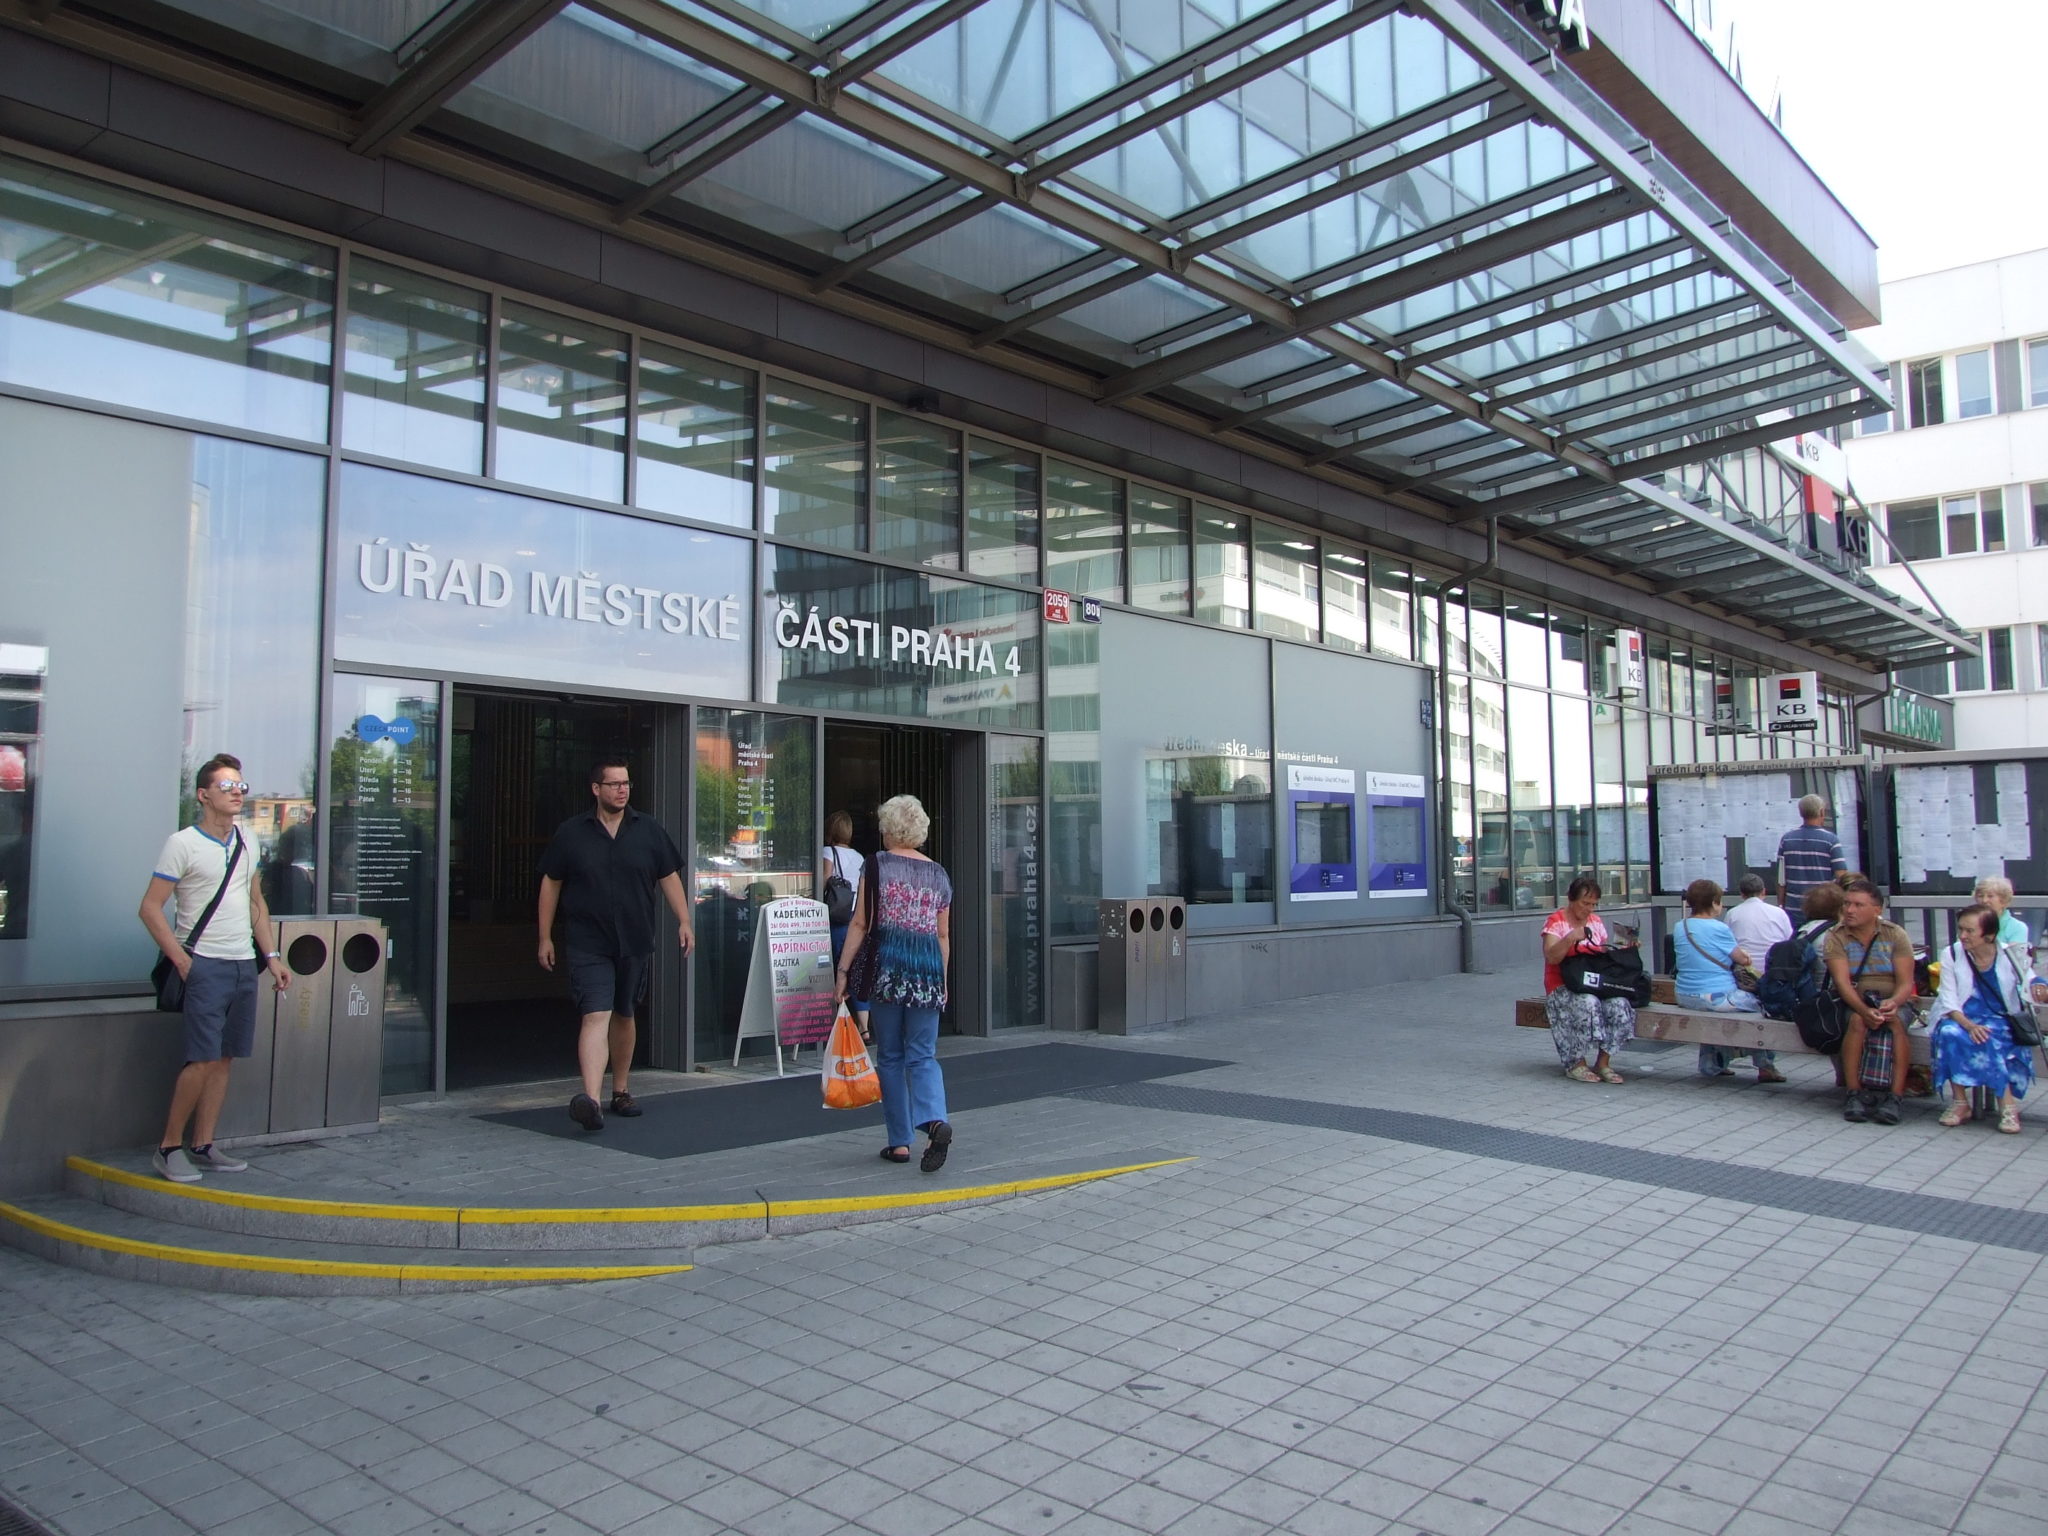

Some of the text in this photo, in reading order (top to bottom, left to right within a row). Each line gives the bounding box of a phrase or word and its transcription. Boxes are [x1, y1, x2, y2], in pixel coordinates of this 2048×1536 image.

[1805, 440, 1819, 462] KB
[1846, 516, 1868, 555] KB
[358, 537, 1021, 677] ÚŘAD MĚSTSKÉ ČÁSTI PRAHA 4
[1047, 592, 1068, 608] 2059
[1628, 667, 1643, 683] KB
[1777, 703, 1807, 715] KB
[1890, 688, 1943, 743] LÉKÁRNA
[1655, 763, 1691, 775] úřední
[1694, 763, 1729, 773] deska
[1811, 760, 1833, 768] Praha
[773, 907, 823, 919] KADEŘNICTVÍ
[1023, 804, 1040, 1015] www.praha4.cz
[772, 939, 830, 954] PAPÍRNICTVÍ
[773, 956, 800, 967] RAZÍTKA
